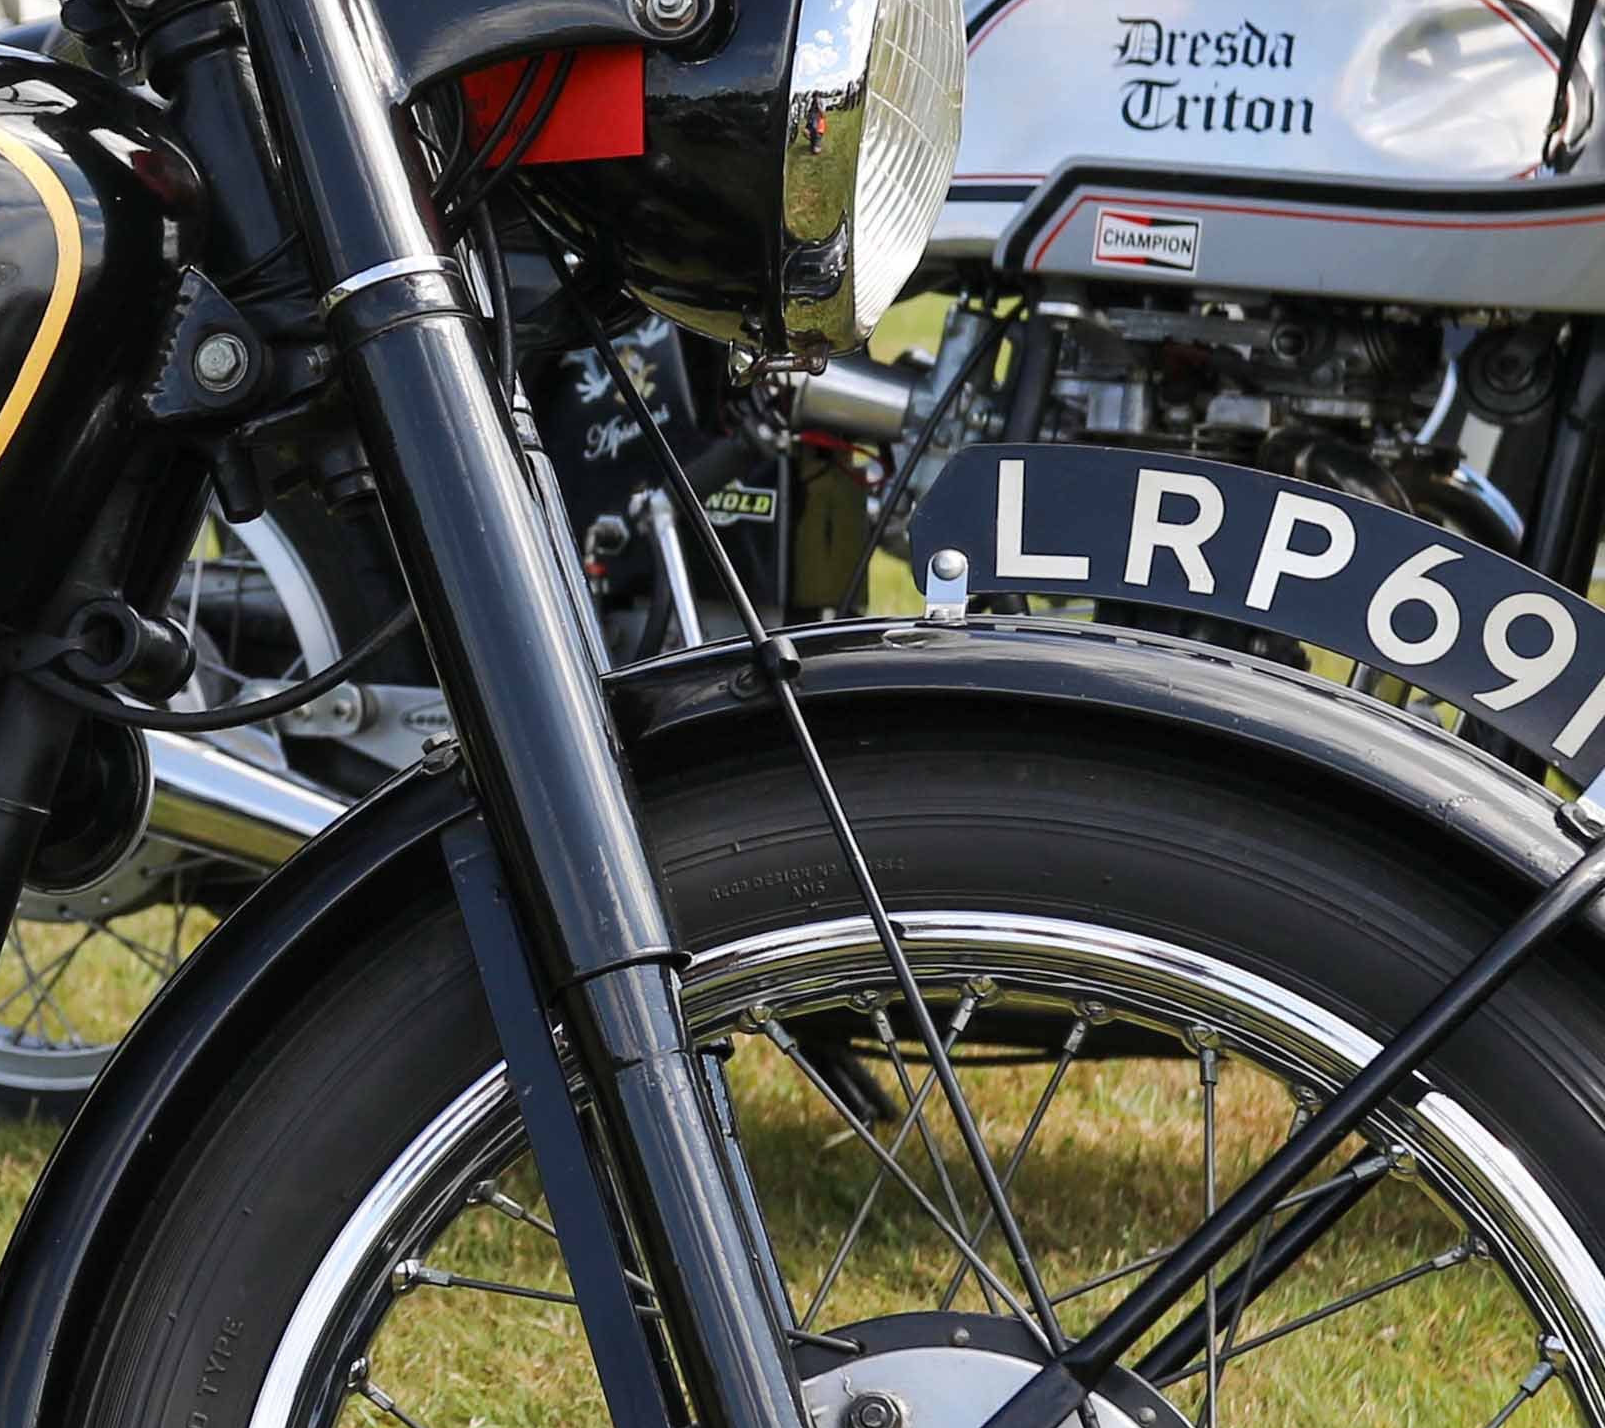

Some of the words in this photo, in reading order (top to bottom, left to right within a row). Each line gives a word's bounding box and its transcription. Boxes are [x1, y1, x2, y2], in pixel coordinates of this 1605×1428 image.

[1113, 16, 1295, 70] Dresda
[1120, 79, 1314, 135] Triton
[1101, 226, 1196, 257] CHAMPION
[705, 492, 770, 513] NOLD
[197, 1316, 244, 1396] TYPE
